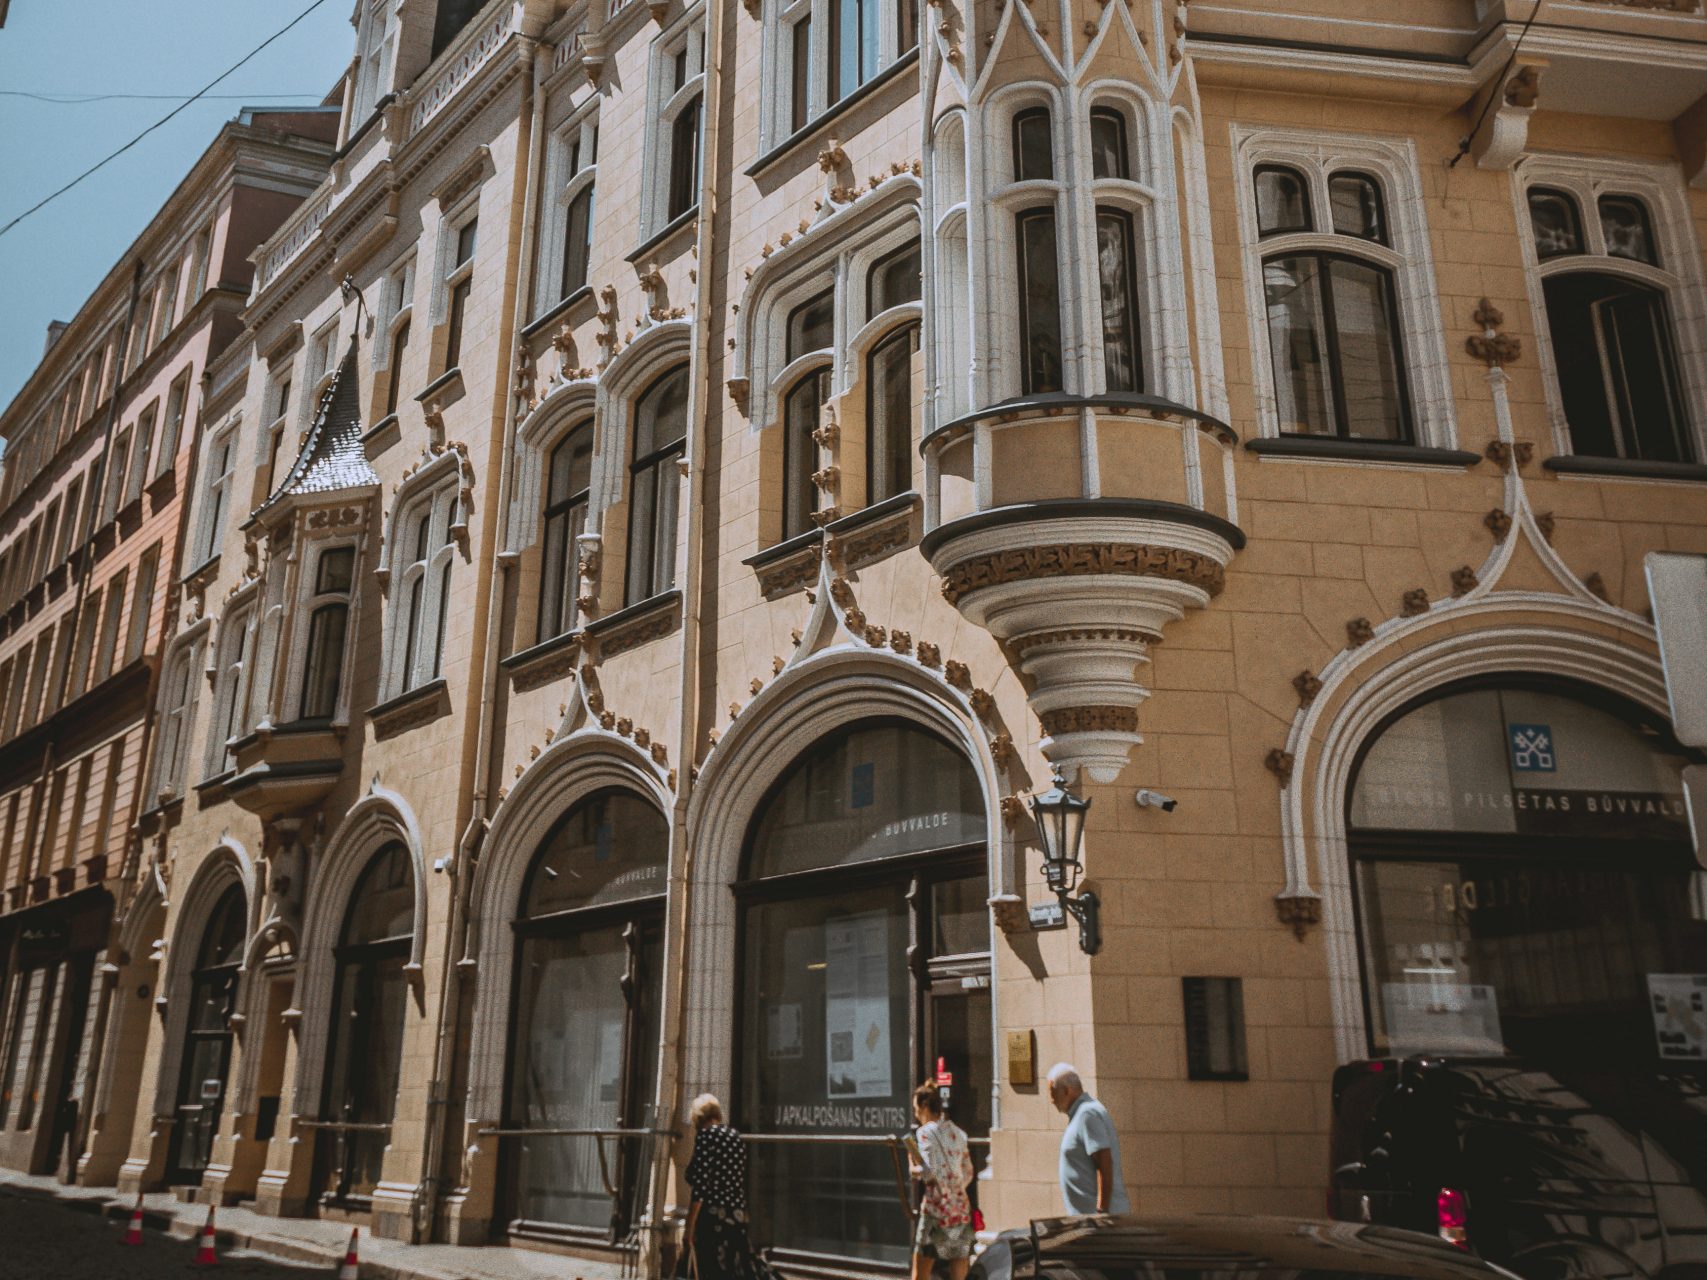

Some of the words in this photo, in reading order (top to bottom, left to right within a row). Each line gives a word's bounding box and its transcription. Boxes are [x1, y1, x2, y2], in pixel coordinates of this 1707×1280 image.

[1463, 789, 1571, 812] PILSĒTAS
[1586, 794, 1684, 816] BŪVVALD
[782, 1101, 861, 1127] APKALPOŠANAS
[863, 1106, 906, 1129] CENTRS
